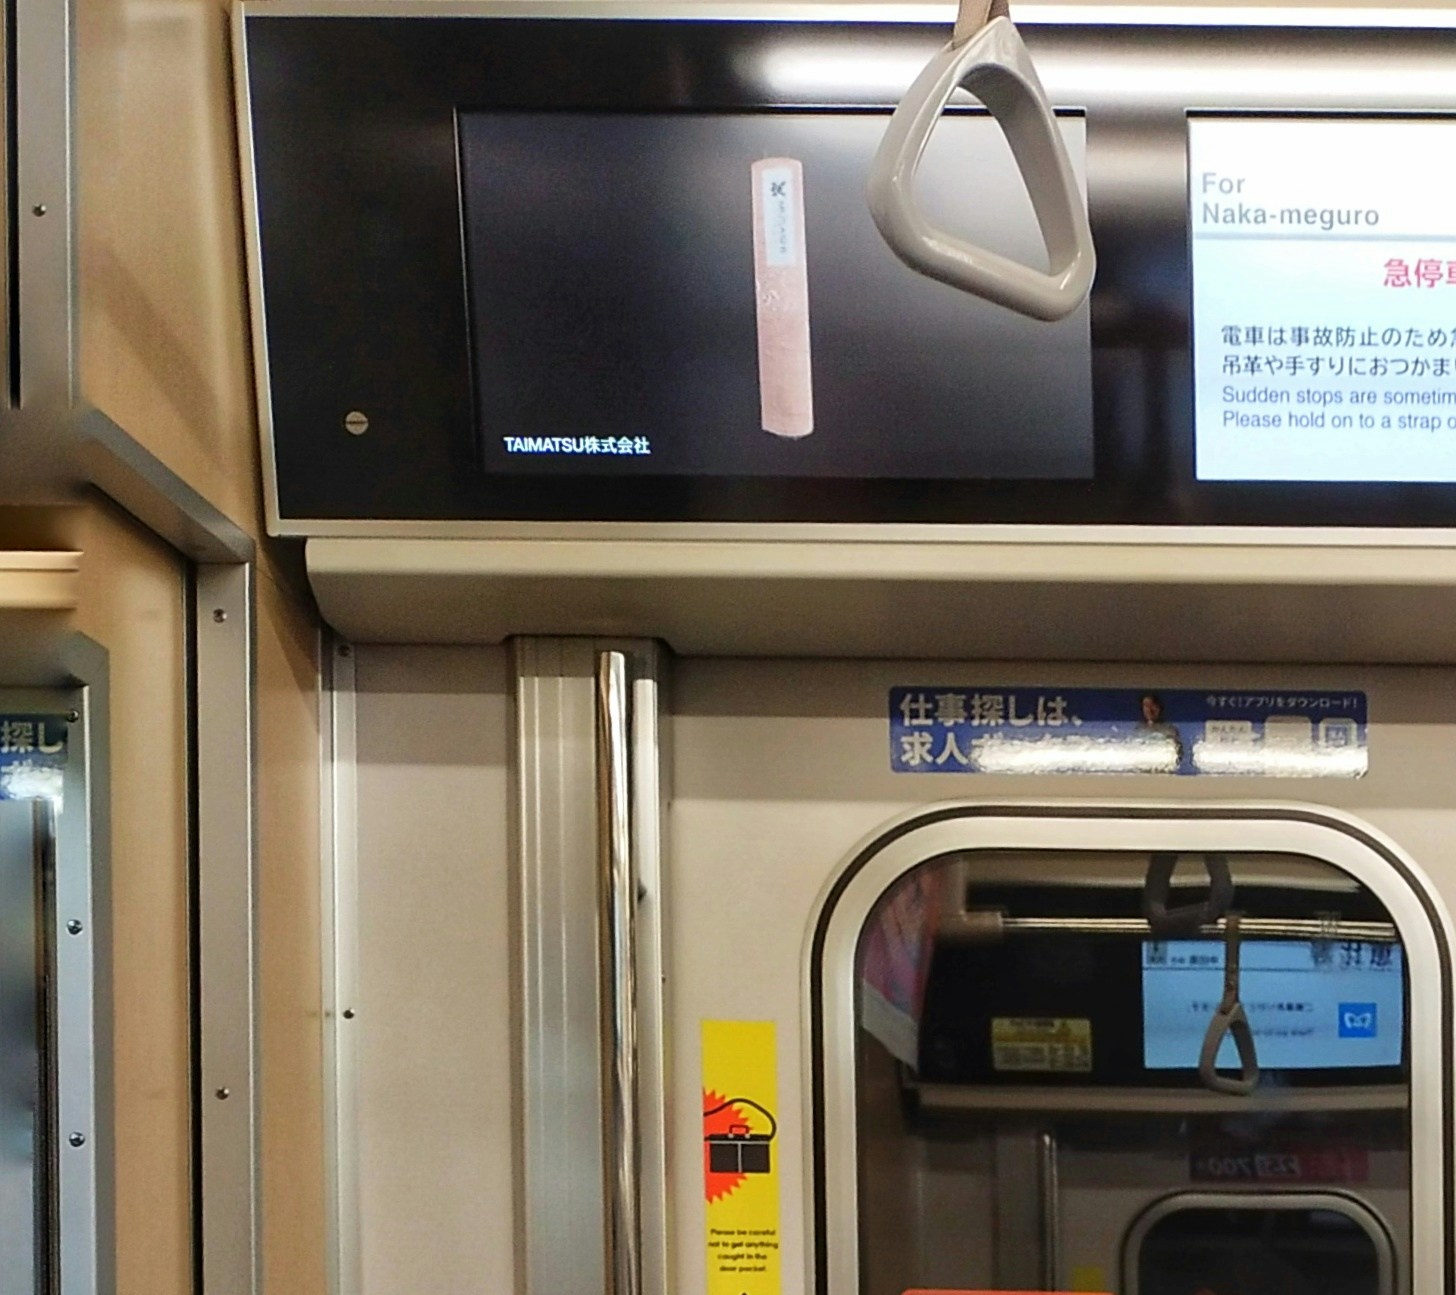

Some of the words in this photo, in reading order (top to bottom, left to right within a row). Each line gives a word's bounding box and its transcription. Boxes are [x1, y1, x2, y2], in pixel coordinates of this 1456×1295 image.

[1202, 172, 1246, 195] For
[1203, 203, 1380, 232] Naka-meguro
[1222, 386, 1291, 404] Sudden
[1296, 387, 1344, 408] stops
[1349, 391, 1378, 405] are
[1222, 411, 1282, 429] Please
[1288, 412, 1326, 429] hold
[1331, 415, 1353, 429] on
[1359, 413, 1376, 430] to
[1381, 416, 1392, 430] a
[1398, 414, 1442, 433] strap
[503, 436, 651, 454] TAIMATSU株式会社
[900, 693, 1084, 728] 仕事探しは、
